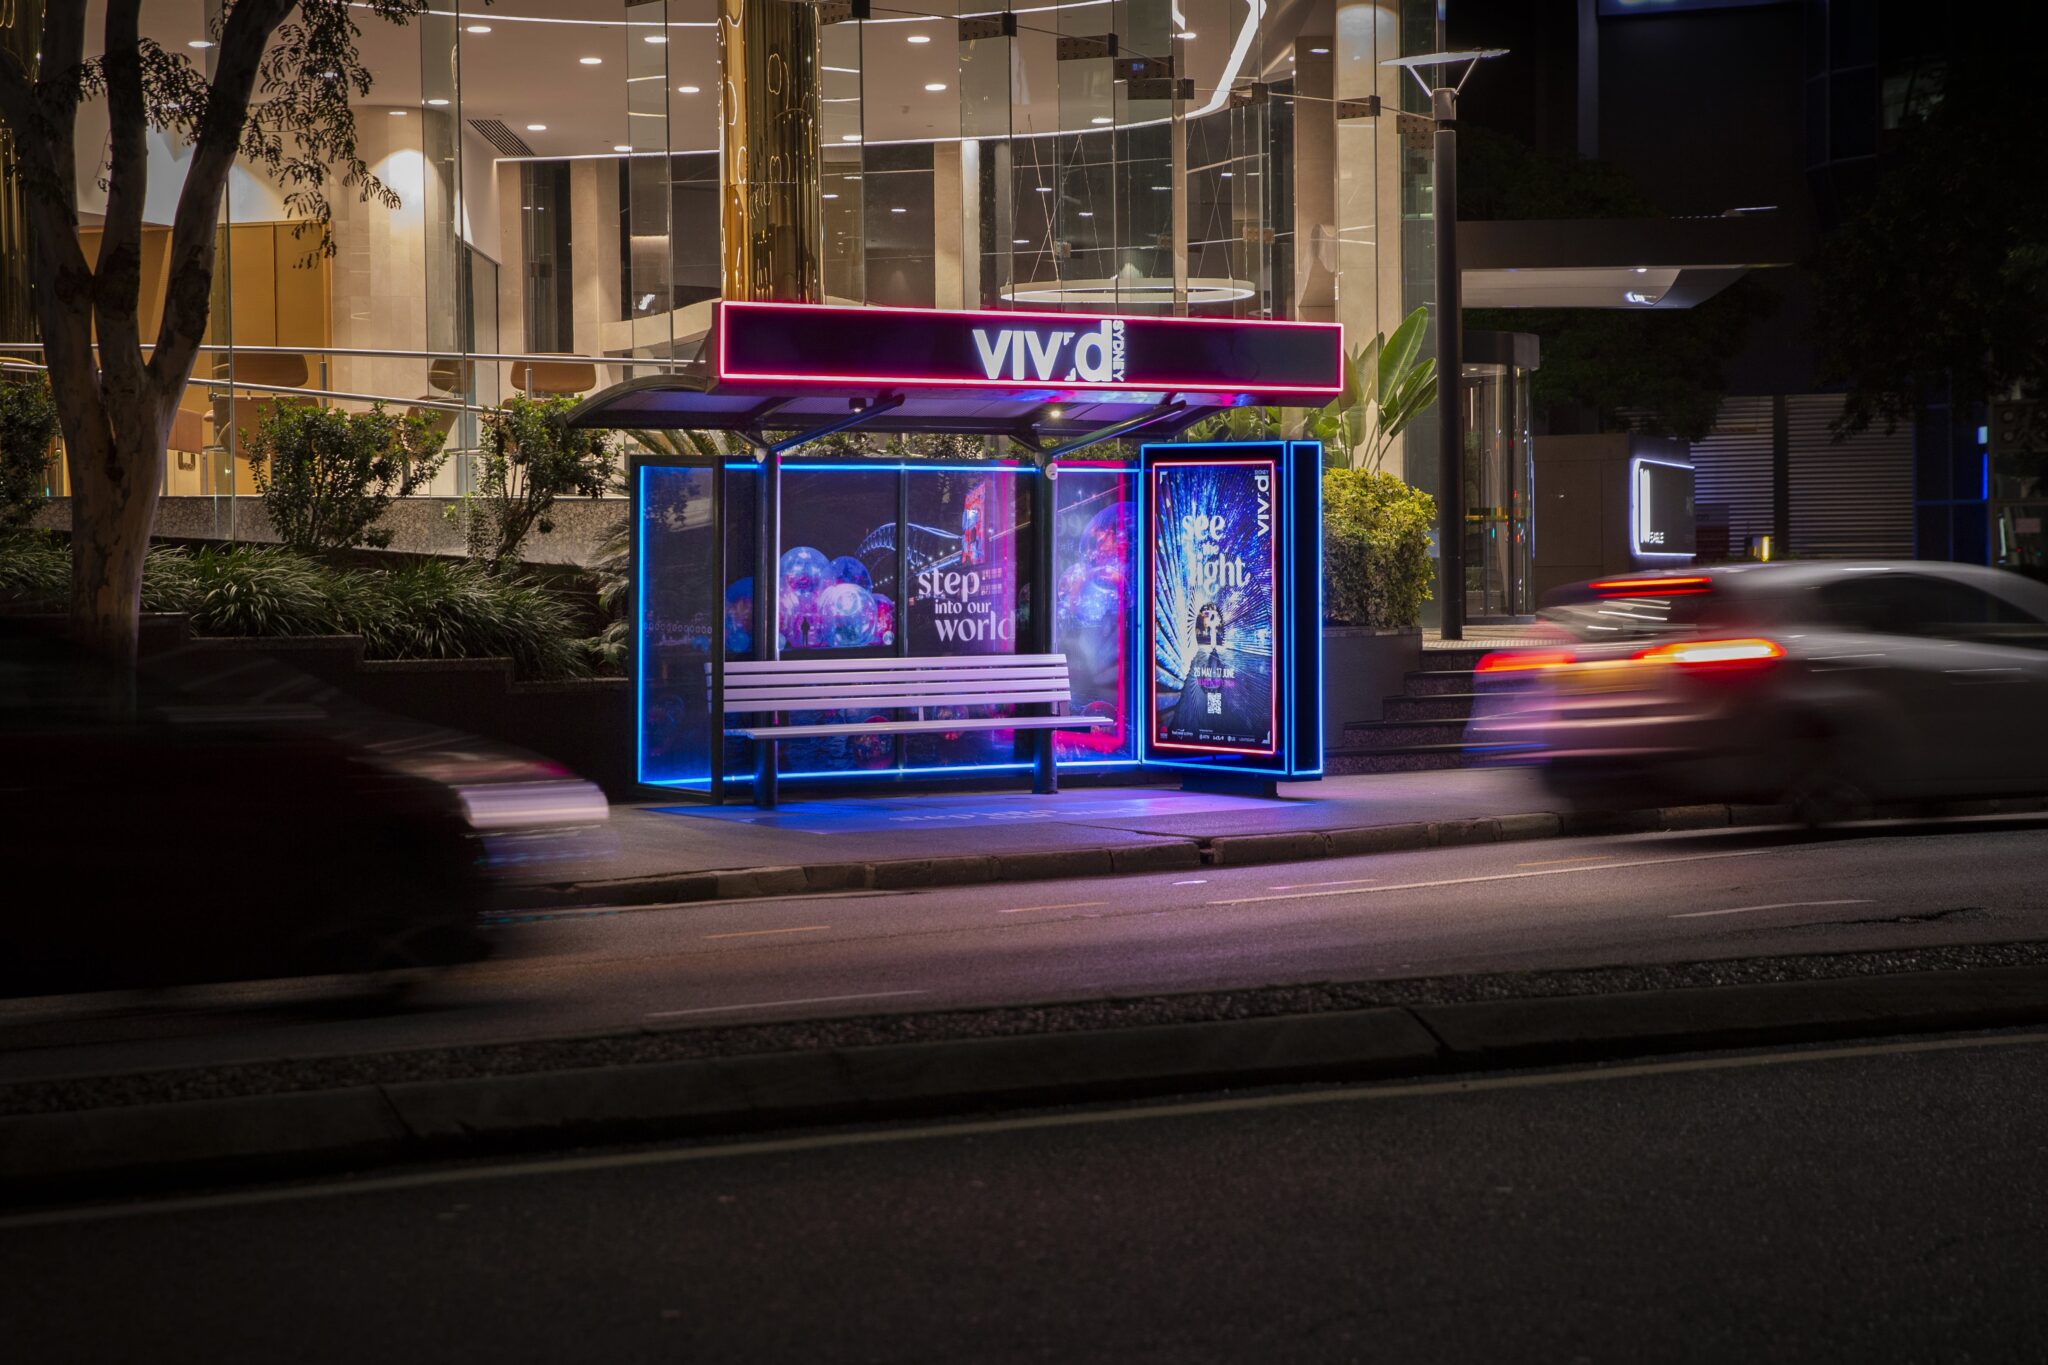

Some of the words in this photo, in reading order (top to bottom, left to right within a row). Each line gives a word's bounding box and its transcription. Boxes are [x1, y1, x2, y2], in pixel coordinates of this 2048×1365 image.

[1113, 320, 1125, 382] SYDNEY
[1182, 515, 1226, 540] see
[918, 568, 980, 602] step
[934, 599, 962, 614] into
[967, 602, 992, 614] our
[934, 611, 1016, 642] world
[1201, 667, 1212, 678] MAY
[1223, 668, 1235, 679] JUNE
